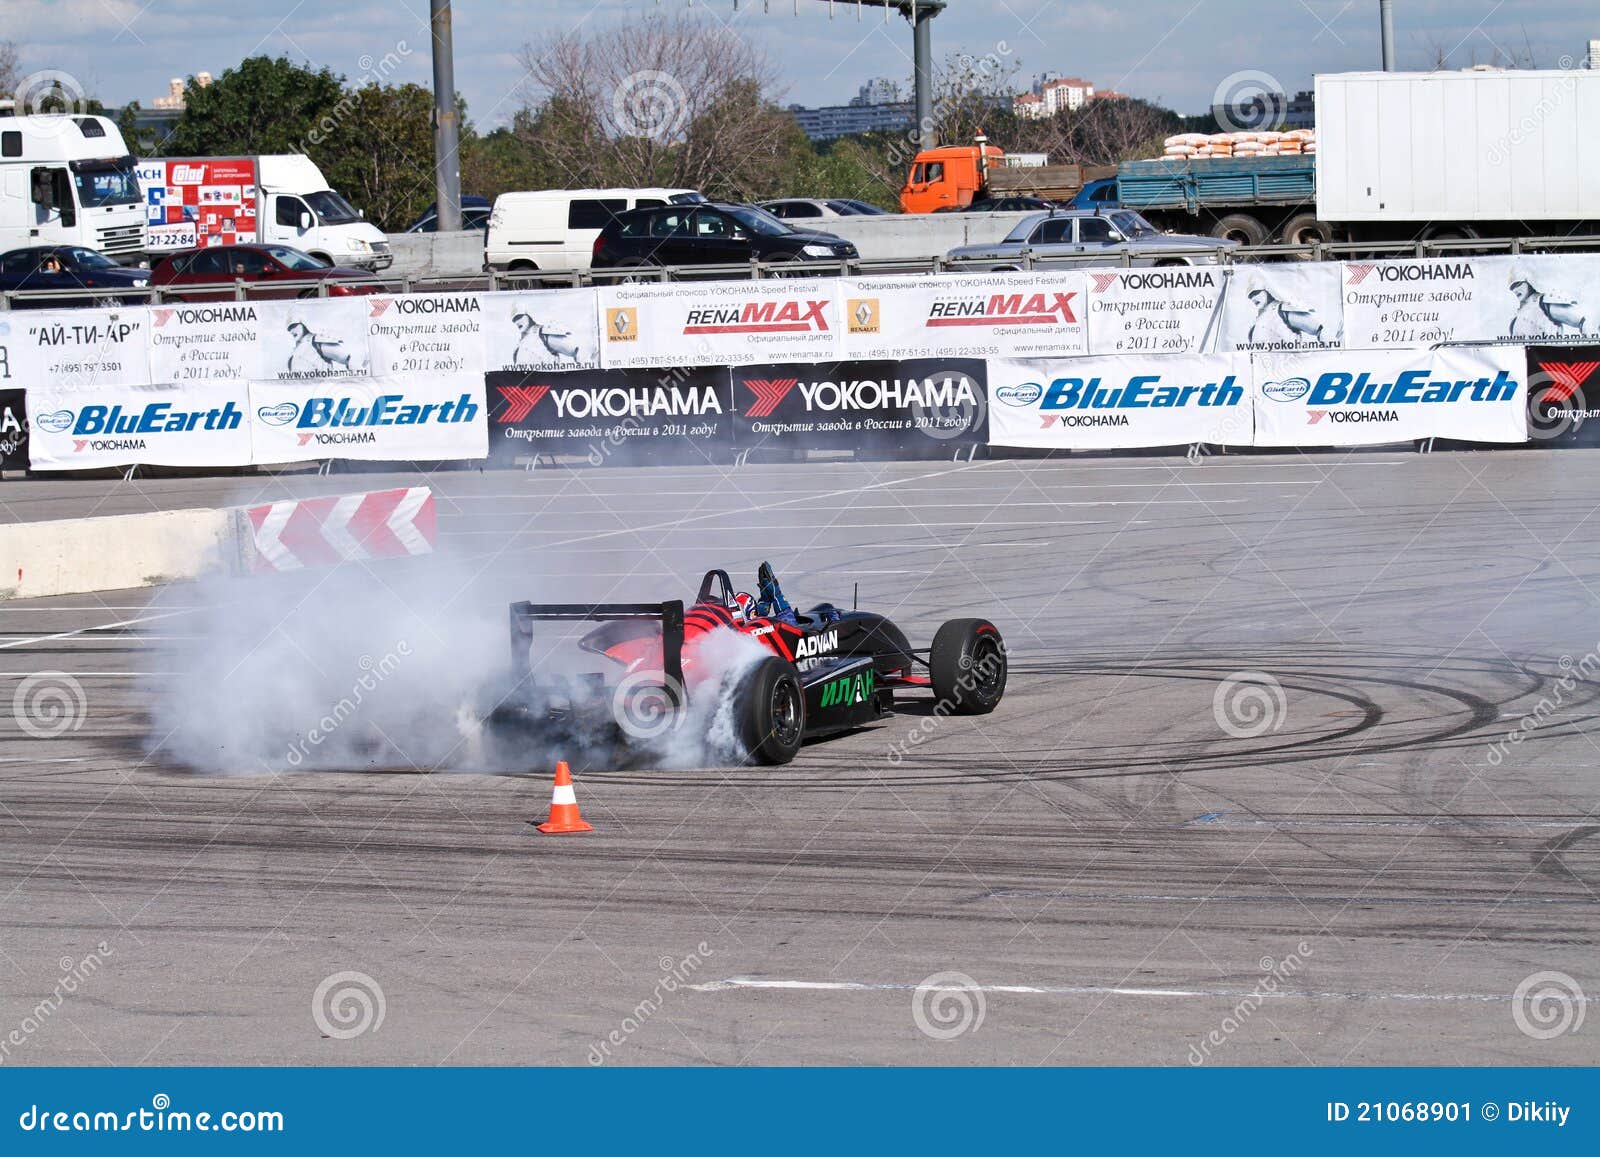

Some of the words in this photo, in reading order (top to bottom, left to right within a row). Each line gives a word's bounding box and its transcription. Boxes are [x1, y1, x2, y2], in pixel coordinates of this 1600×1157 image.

[1377, 264, 1474, 282] YOKOHAMA
[858, 281, 917, 291] Официальный
[918, 280, 952, 289] спонсор
[954, 278, 1006, 287] YOKOHAMA
[1008, 277, 1034, 287] Speed
[1035, 276, 1067, 285] Festival
[1120, 272, 1215, 290] YOKOHAMA
[616, 290, 674, 300] Официальный
[675, 289, 708, 298] спонсор
[710, 286, 759, 296] YOKOHAMA
[761, 285, 787, 295] Speed
[788, 284, 819, 293] Festival
[1346, 291, 1424, 308] Открытие
[1428, 287, 1473, 302] завода
[395, 297, 481, 314] YOKOHAMA
[1091, 300, 1166, 316] Открытие
[1168, 295, 1213, 311] завода
[177, 307, 258, 324] YOKOHAMA
[1380, 314, 1388, 323] в
[1392, 310, 1440, 323] России
[370, 323, 437, 339] Открытие
[440, 320, 480, 334] завода
[992, 326, 1053, 336] Официальный
[1055, 325, 1081, 335] дилер
[1124, 321, 1131, 331] в
[1135, 317, 1181, 331] России
[153, 333, 216, 348] Открытие
[218, 328, 257, 343] завода
[747, 334, 806, 344] Официальный
[809, 334, 833, 343] дилер
[1371, 333, 1378, 343] в
[1384, 330, 1415, 343] 2011
[1420, 327, 1454, 345] году!
[410, 340, 451, 353] России
[1014, 343, 1081, 352] www.renamax.ru
[1116, 341, 1123, 351] в
[1127, 337, 1157, 350] 2011
[1162, 336, 1195, 352] году!
[1236, 338, 1341, 352] www.yokohama.ru
[180, 352, 187, 361] в
[190, 349, 230, 361] России
[628, 356, 648, 366] (495)
[715, 353, 755, 363] 22-333-55
[768, 350, 833, 360] www.renamax.ru
[868, 348, 889, 358] (495)
[935, 347, 957, 357] (495)
[959, 346, 999, 355] 22-333-55
[102, 362, 121, 372] 3501
[392, 362, 398, 371] в
[402, 358, 430, 371] 2011
[433, 357, 464, 372] году!
[502, 360, 595, 372] www.yokohama.ru
[174, 371, 179, 380] в
[183, 367, 210, 379] 2011
[213, 366, 242, 380] году!
[278, 368, 367, 380] www.yokohama.ru
[798, 377, 977, 411] YOKOHAMA
[1039, 375, 1244, 410] BluEarth
[1306, 371, 1519, 405] BluEarth
[550, 386, 722, 418] YOKOHAMA
[72, 401, 243, 435] BluEarth
[296, 394, 480, 428] BluEarth
[1328, 410, 1399, 423] YOKOHAMA
[751, 422, 814, 436] Открытие
[816, 418, 852, 431] завода
[855, 422, 861, 430] в
[864, 418, 903, 430] России
[905, 420, 911, 429] в
[915, 417, 941, 428] 2011
[944, 415, 971, 431] году!
[1061, 415, 1129, 427] YOKOHAMA
[315, 432, 376, 444] YOKOHAMA
[505, 427, 565, 441] Открытие
[567, 424, 601, 437] завода
[605, 428, 611, 437] в
[614, 425, 650, 437] России
[653, 428, 659, 437] в
[662, 425, 687, 436] 2011
[690, 423, 717, 438] году!
[91, 440, 146, 451] YOKOHAMA
[795, 630, 838, 659] ADVAN
